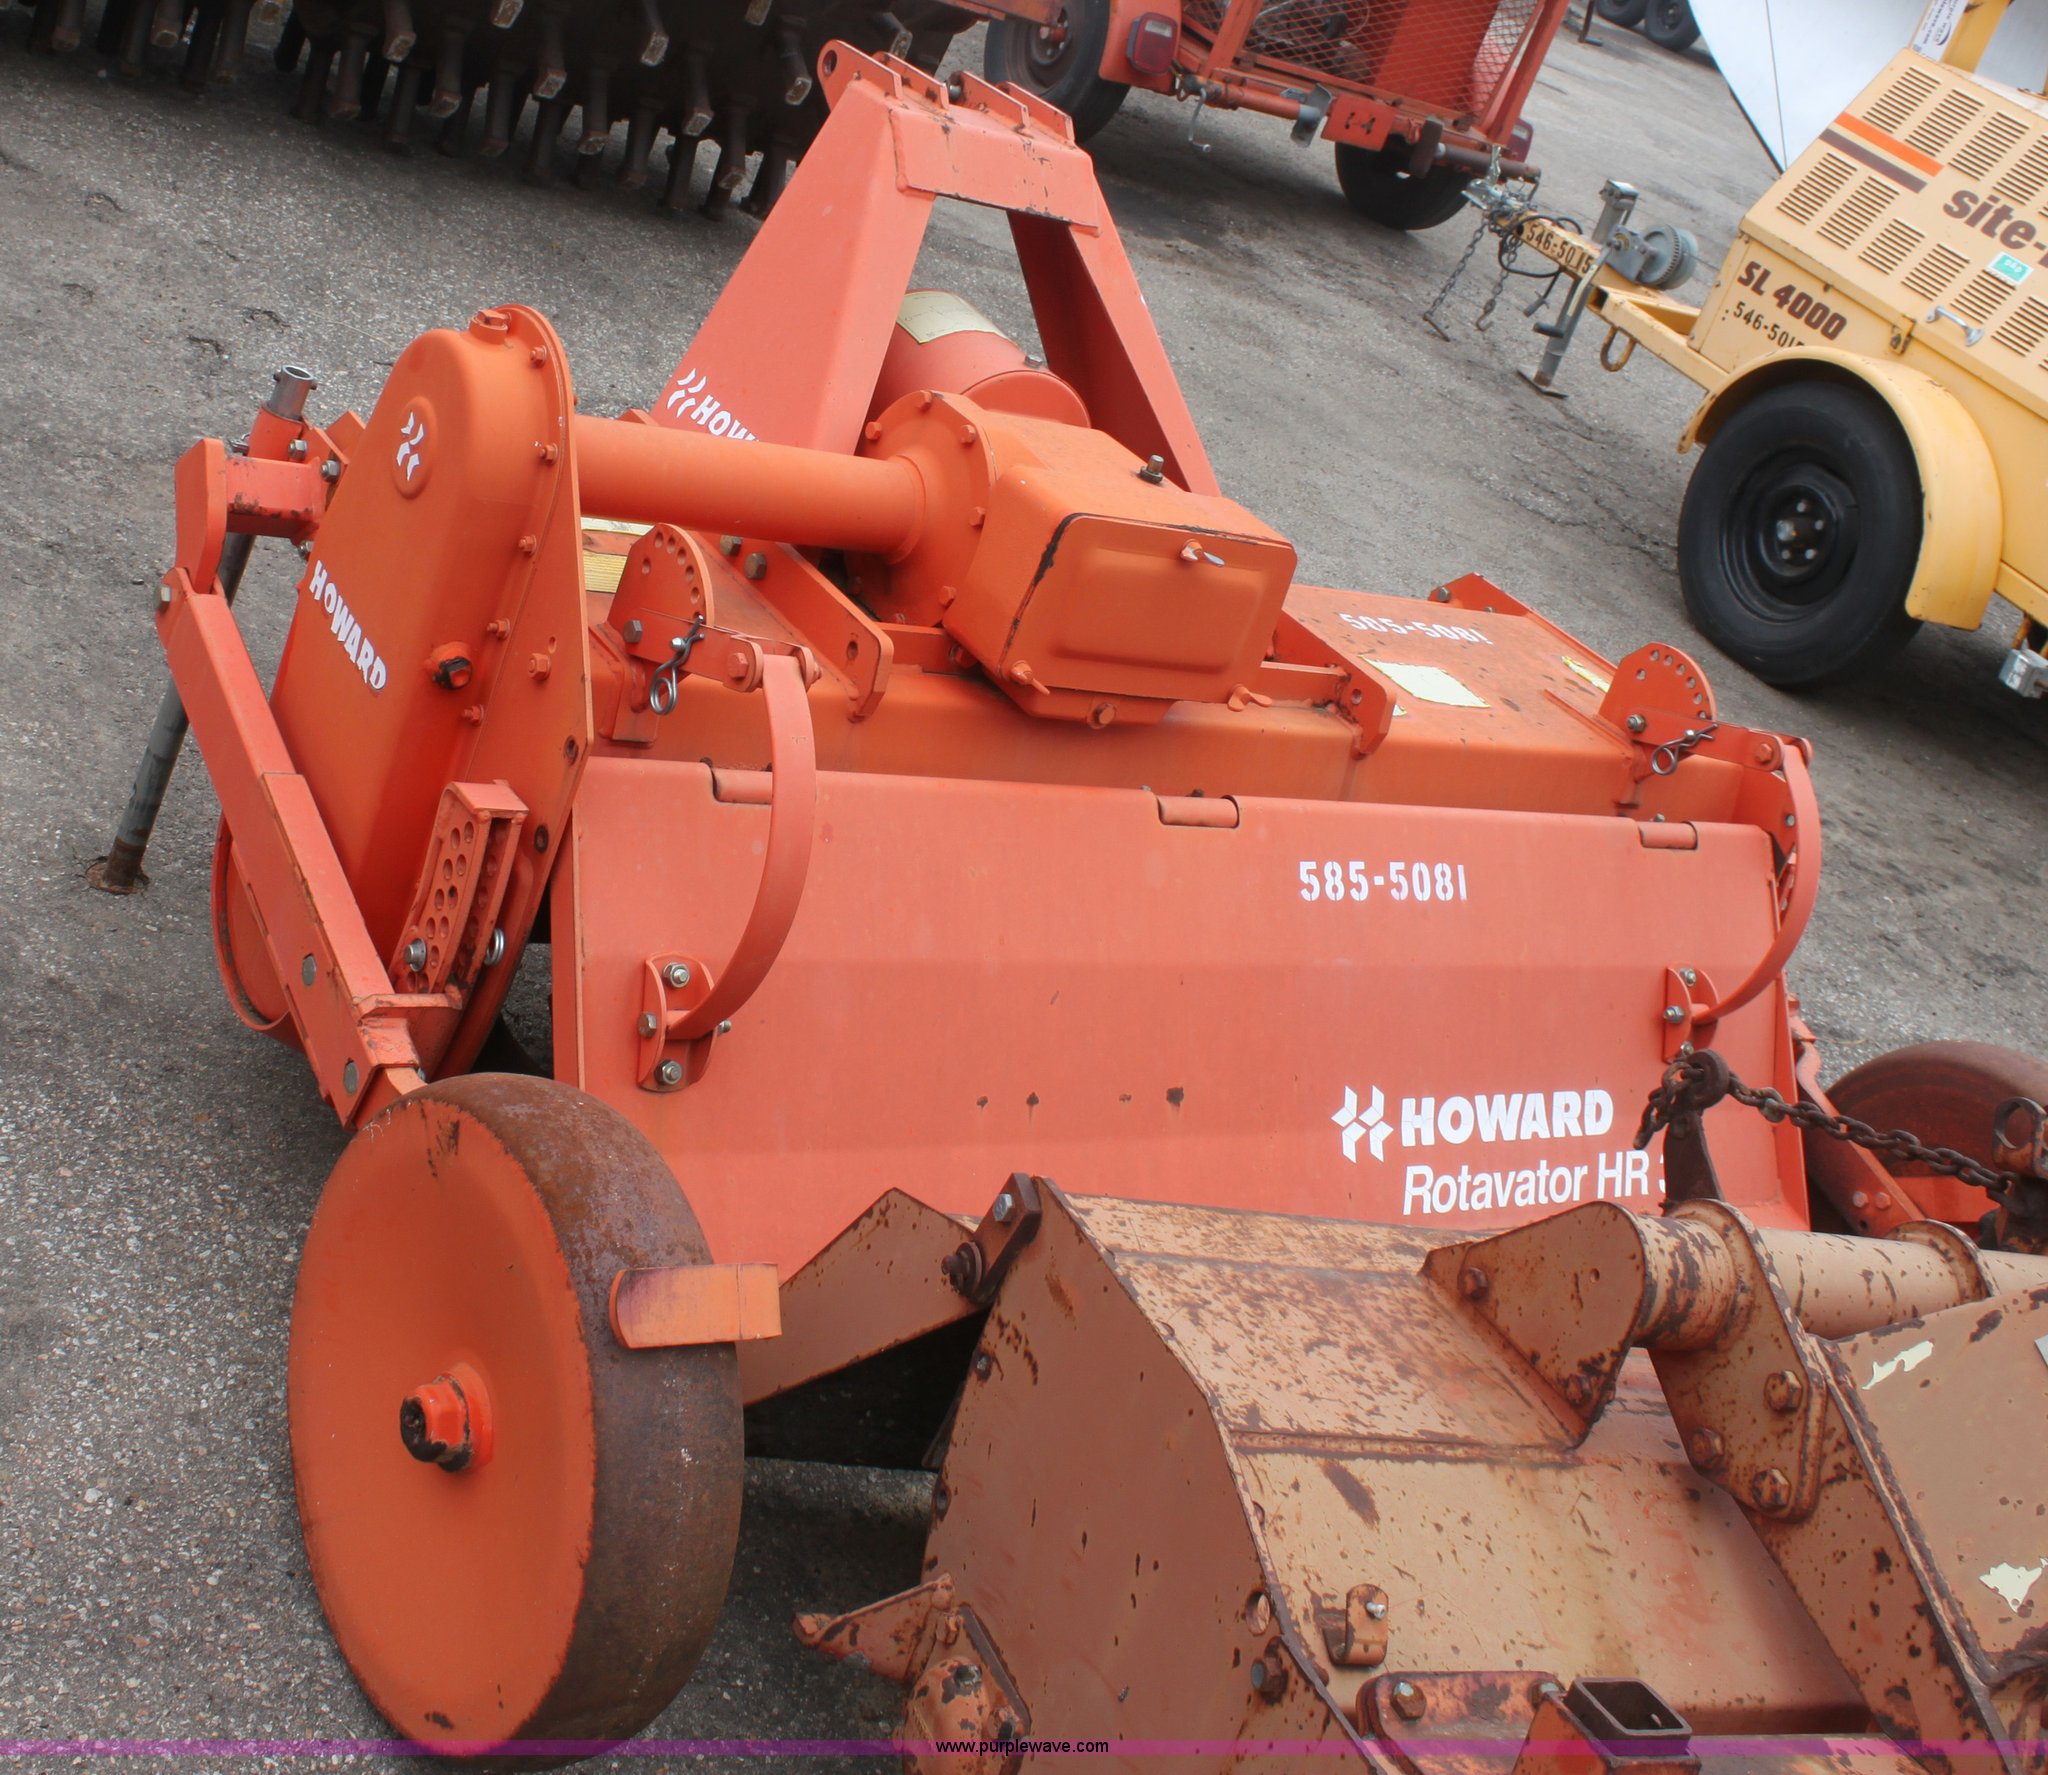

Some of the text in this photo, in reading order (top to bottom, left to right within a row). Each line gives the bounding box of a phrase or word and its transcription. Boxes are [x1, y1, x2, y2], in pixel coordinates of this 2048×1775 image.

[1737, 260, 1848, 341] SL 4000
[689, 394, 758, 441] HOW
[308, 559, 387, 690] HOWARD
[1298, 860, 1468, 902] 585-5081
[1400, 1088, 1614, 1148] HOWARD
[1401, 1159, 1589, 1216] Rotavator
[1596, 1149, 1650, 1200] HR
